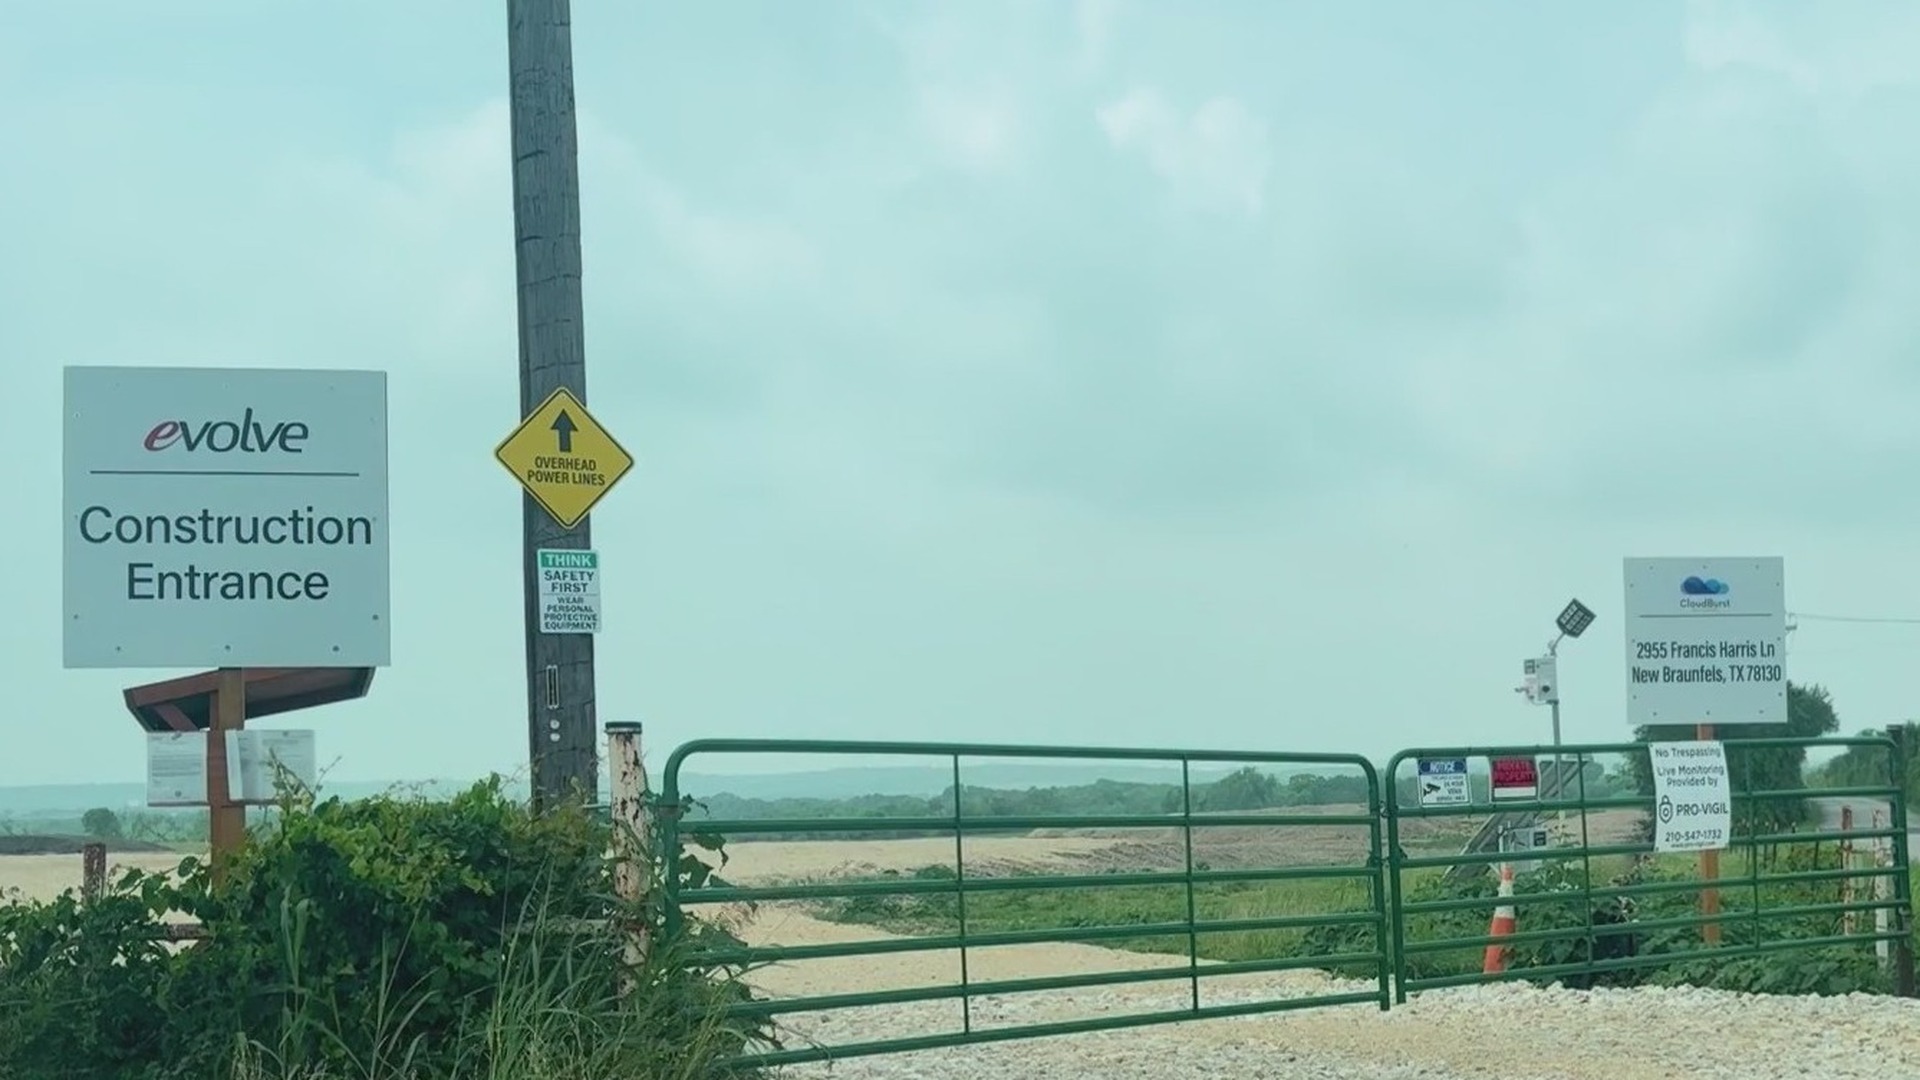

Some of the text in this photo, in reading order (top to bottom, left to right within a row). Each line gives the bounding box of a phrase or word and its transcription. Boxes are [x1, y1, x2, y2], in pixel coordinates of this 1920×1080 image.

[143, 407, 309, 453] evolve
[534, 456, 597, 471] OVERHEAD
[527, 470, 606, 486] POWER LINES
[79, 505, 372, 546] Construction
[546, 553, 592, 567] THINK
[127, 563, 330, 601] Entrance
[544, 570, 595, 582] SAFETY
[551, 582, 589, 593] FIRST
[557, 596, 584, 605] WEAR
[1679, 598, 1731, 608] CloudBurst
[546, 604, 594, 613] PERSONAL
[543, 612, 598, 622] PROTECTIVE
[544, 621, 598, 631] EQUIPMENT
[1636, 640, 1775, 660] 2955 Francis Harris Ln
[1632, 664, 1782, 685] New Braunfels, TX 78130
[1655, 747, 1721, 759] No Trespassing
[1429, 761, 1455, 773] NOTICE
[1657, 765, 1725, 776] Live Monitoring
[1666, 776, 1719, 788] Provided by
[1676, 803, 1728, 816] PRO-VIGIL
[1665, 829, 1722, 842] 210-547-1732
